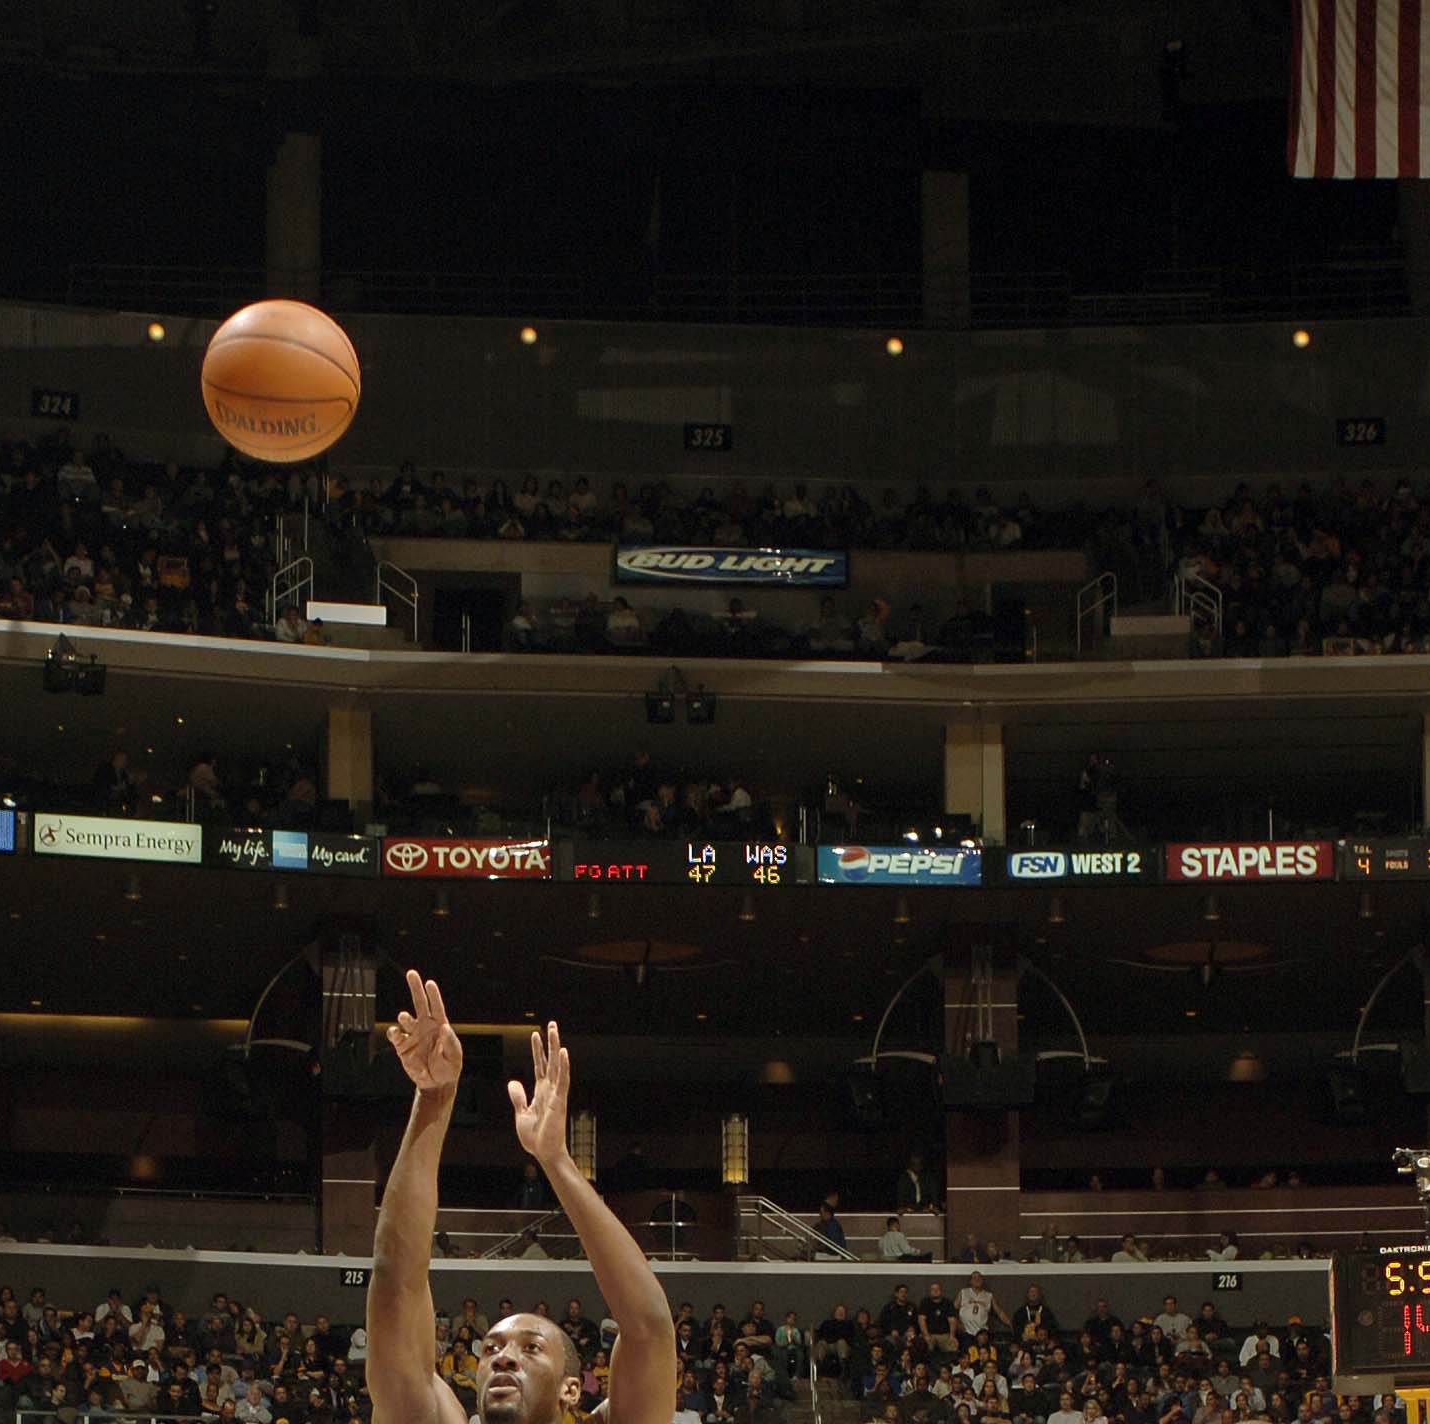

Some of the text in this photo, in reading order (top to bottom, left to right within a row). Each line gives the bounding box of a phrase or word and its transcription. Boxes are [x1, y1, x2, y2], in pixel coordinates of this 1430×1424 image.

[692, 427, 725, 448] 325
[1344, 421, 1378, 442] 326
[637, 553, 835, 573] BUD LIGHT
[66, 828, 195, 856] Sempra Energy
[219, 839, 243, 862] My
[312, 845, 334, 866] My
[433, 846, 546, 869] TOYOTA
[688, 844, 787, 866] LA WAS
[866, 853, 962, 875] PEPSI
[1017, 853, 1141, 875] FSN WEST 2
[1181, 845, 1318, 877] STAPLES
[574, 865, 648, 879] FG ATT
[688, 865, 780, 884] 47 46
[1357, 857, 1370, 875] 4
[344, 1270, 364, 1286] 215
[1218, 1274, 1238, 1289] 216
